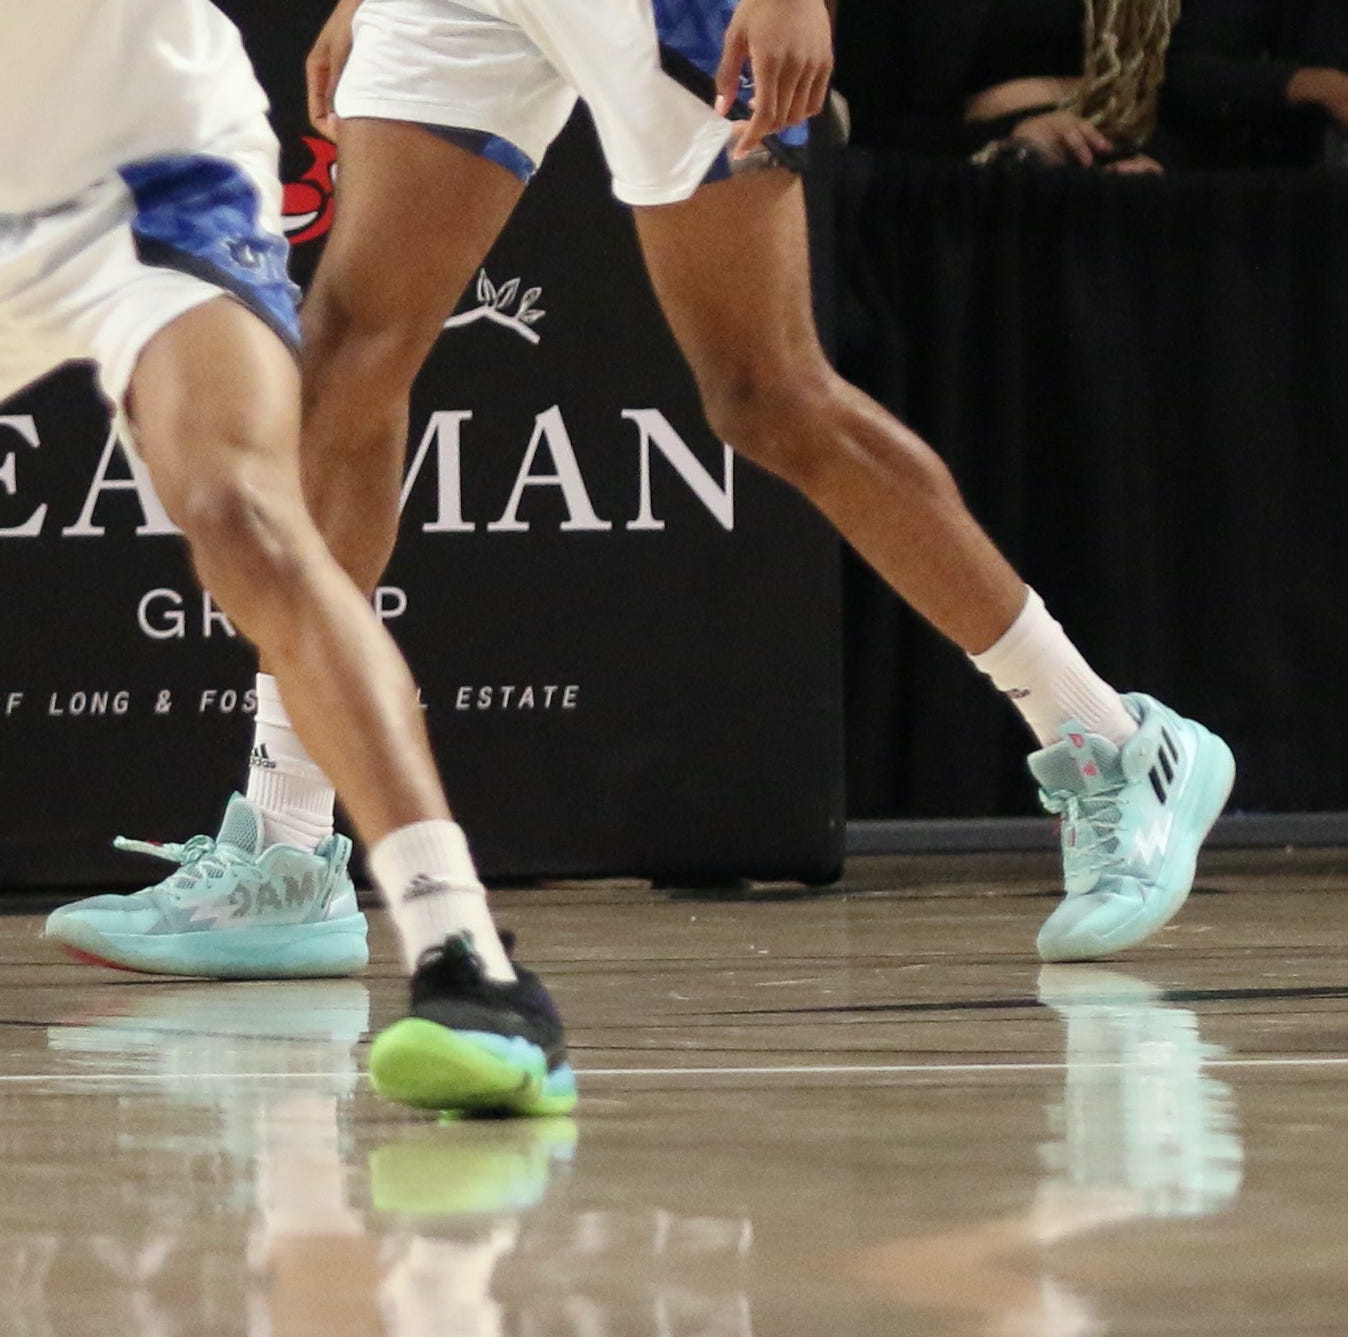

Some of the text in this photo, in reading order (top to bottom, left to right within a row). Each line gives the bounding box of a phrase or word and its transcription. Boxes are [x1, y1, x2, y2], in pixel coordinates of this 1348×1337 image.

[137, 586, 408, 639] GRP
[48, 691, 130, 716] LONG
[155, 691, 172, 714] &
[456, 686, 580, 710] ESTATE
